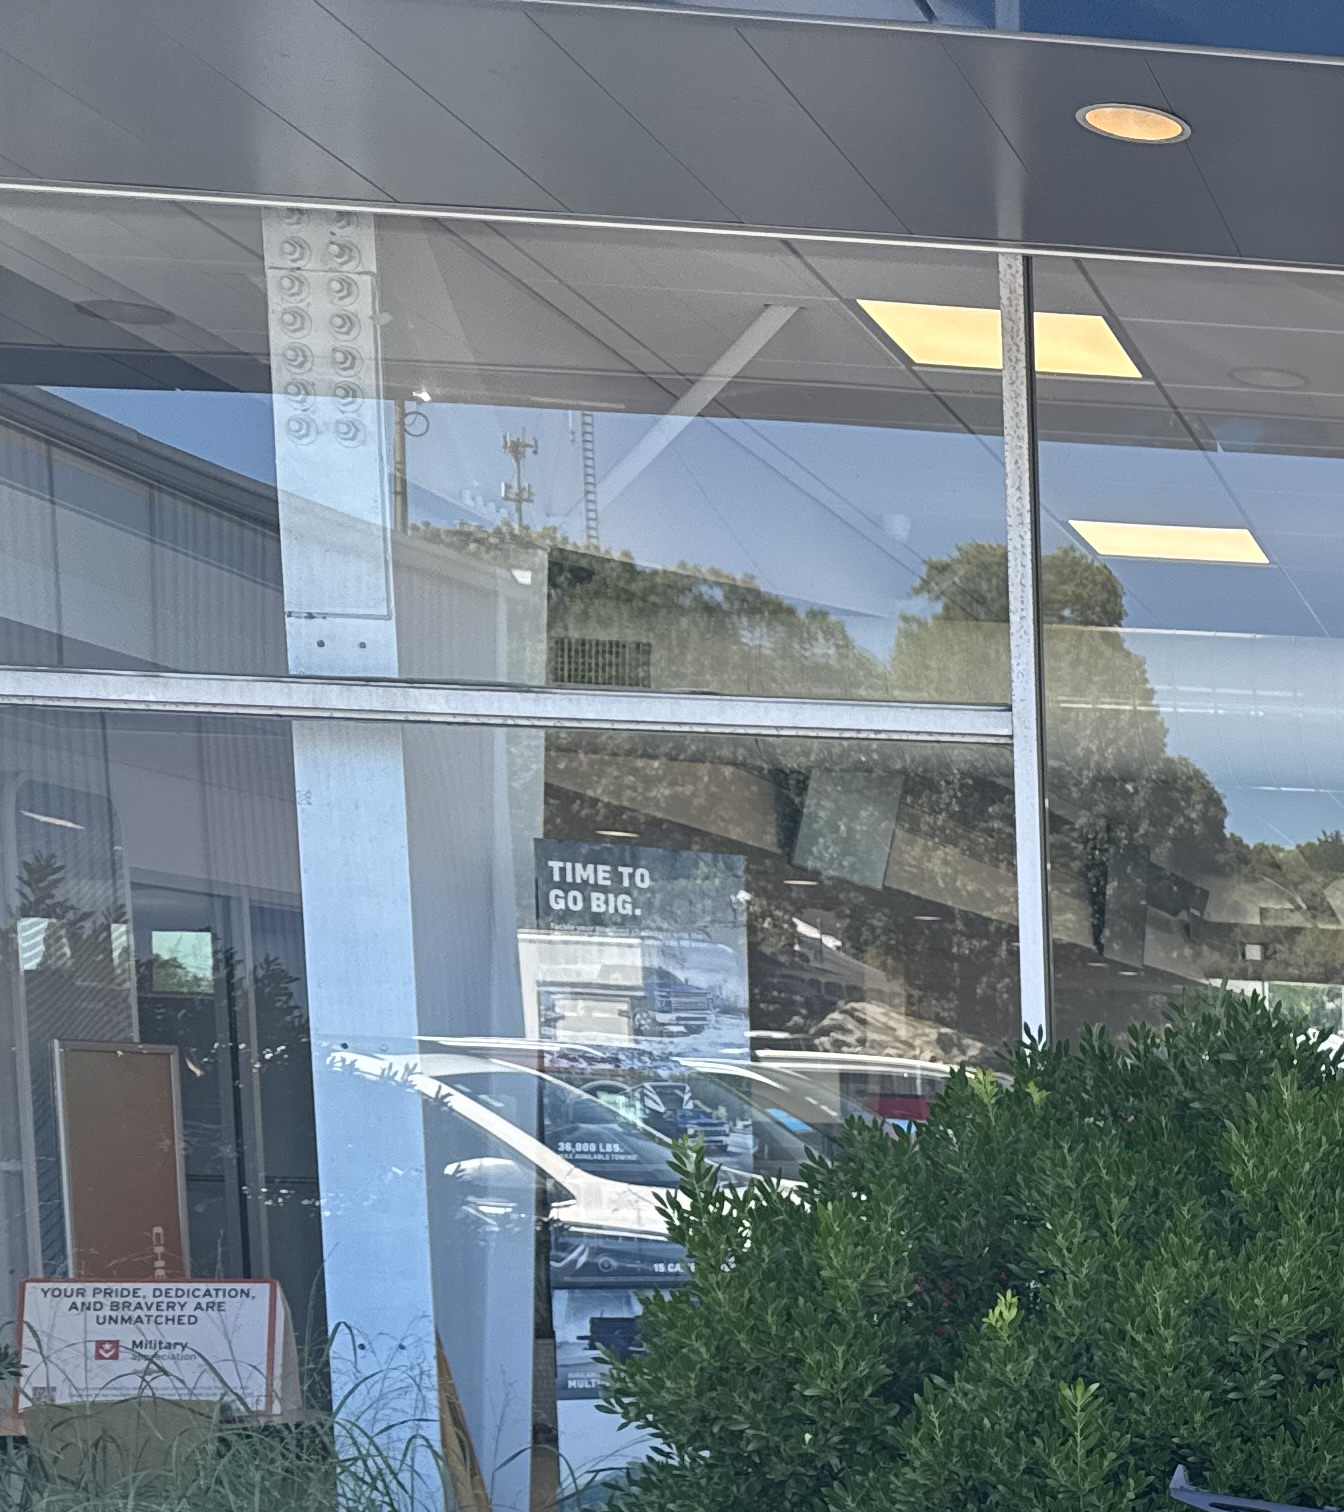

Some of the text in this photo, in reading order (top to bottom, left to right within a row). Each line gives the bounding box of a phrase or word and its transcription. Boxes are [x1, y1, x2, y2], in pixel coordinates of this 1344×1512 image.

[548, 861, 650, 889] TIME TO
[549, 889, 642, 916] GO BIG.
[599, 1143, 624, 1153] LBS.
[41, 1288, 256, 1301] YOUR PRIDE, DEDICATION,
[68, 1301, 226, 1312] AND BRAVERY ARE
[96, 1314, 198, 1326] UNMATCHED
[131, 1340, 188, 1352] Military
